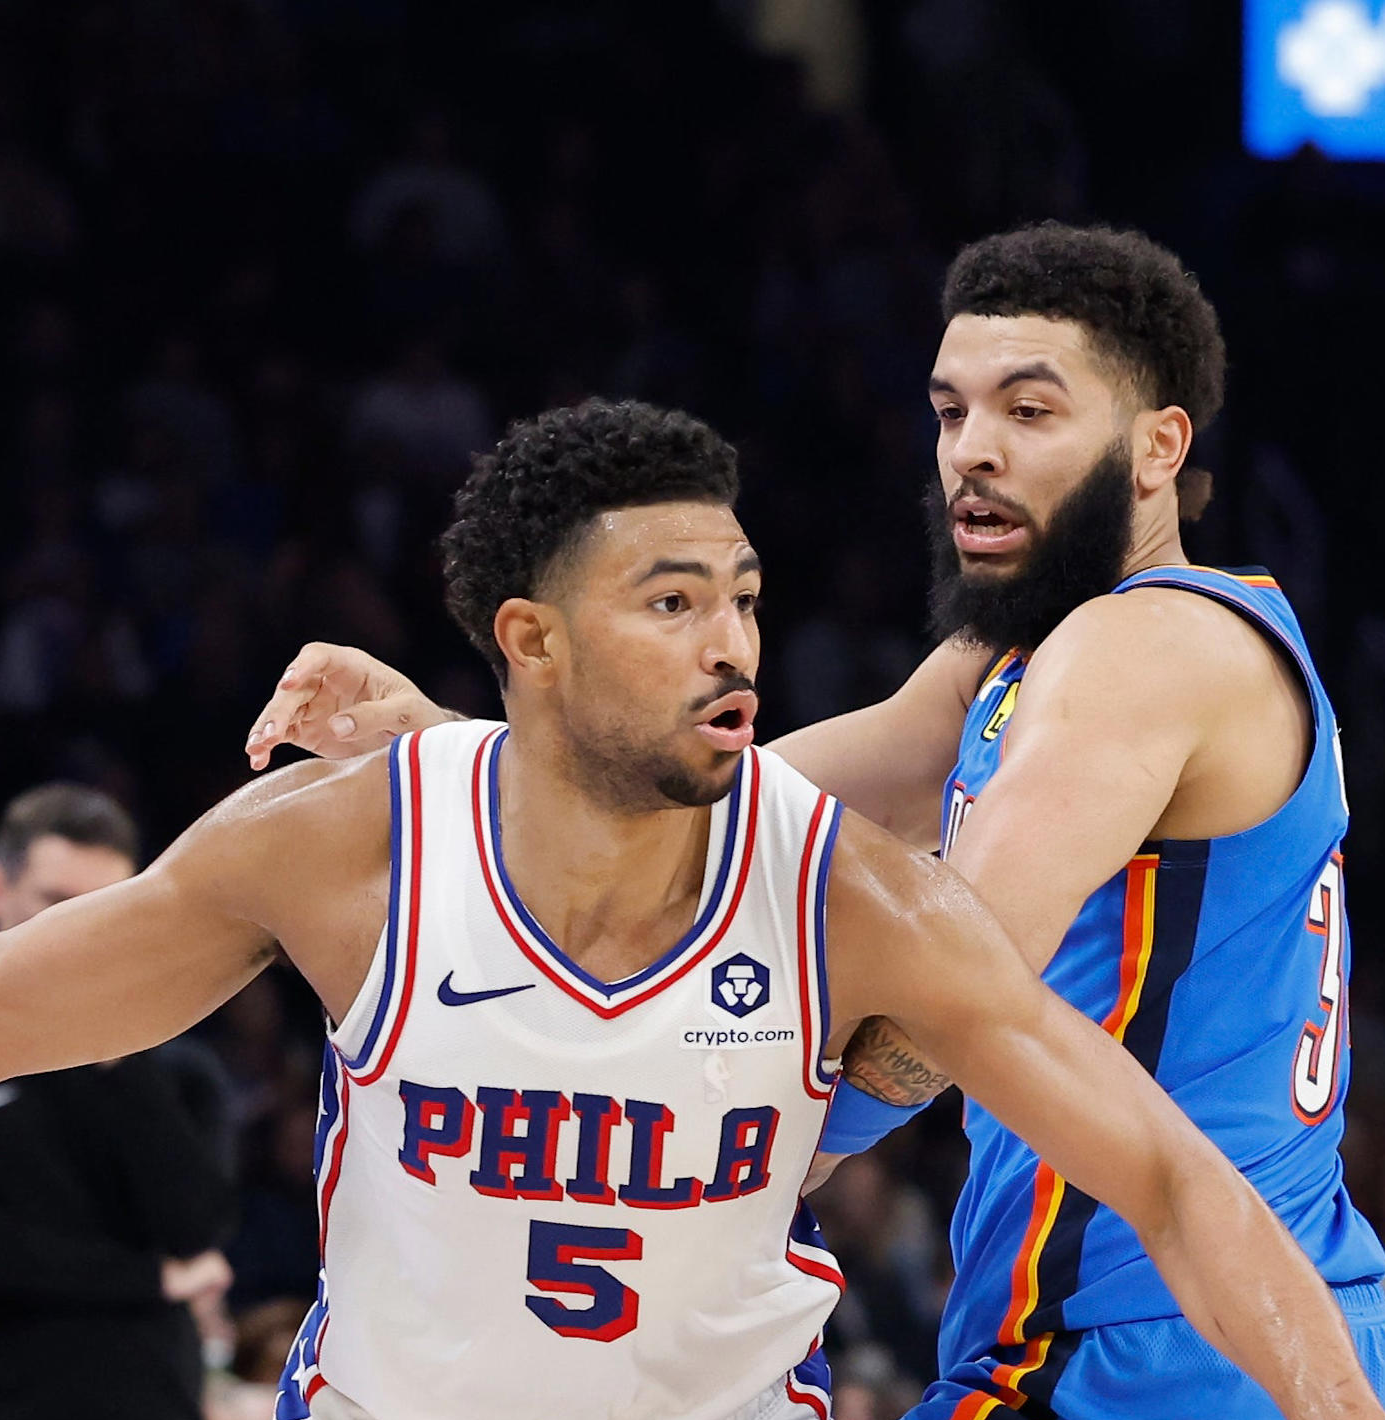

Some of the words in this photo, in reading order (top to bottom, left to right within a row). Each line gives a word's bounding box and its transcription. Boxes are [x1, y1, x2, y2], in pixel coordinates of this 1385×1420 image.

[684, 1029, 795, 1046] crypto.com
[1290, 850, 1352, 1127] 3
[398, 1079, 780, 1211] PHILA
[525, 1219, 643, 1343] 5
